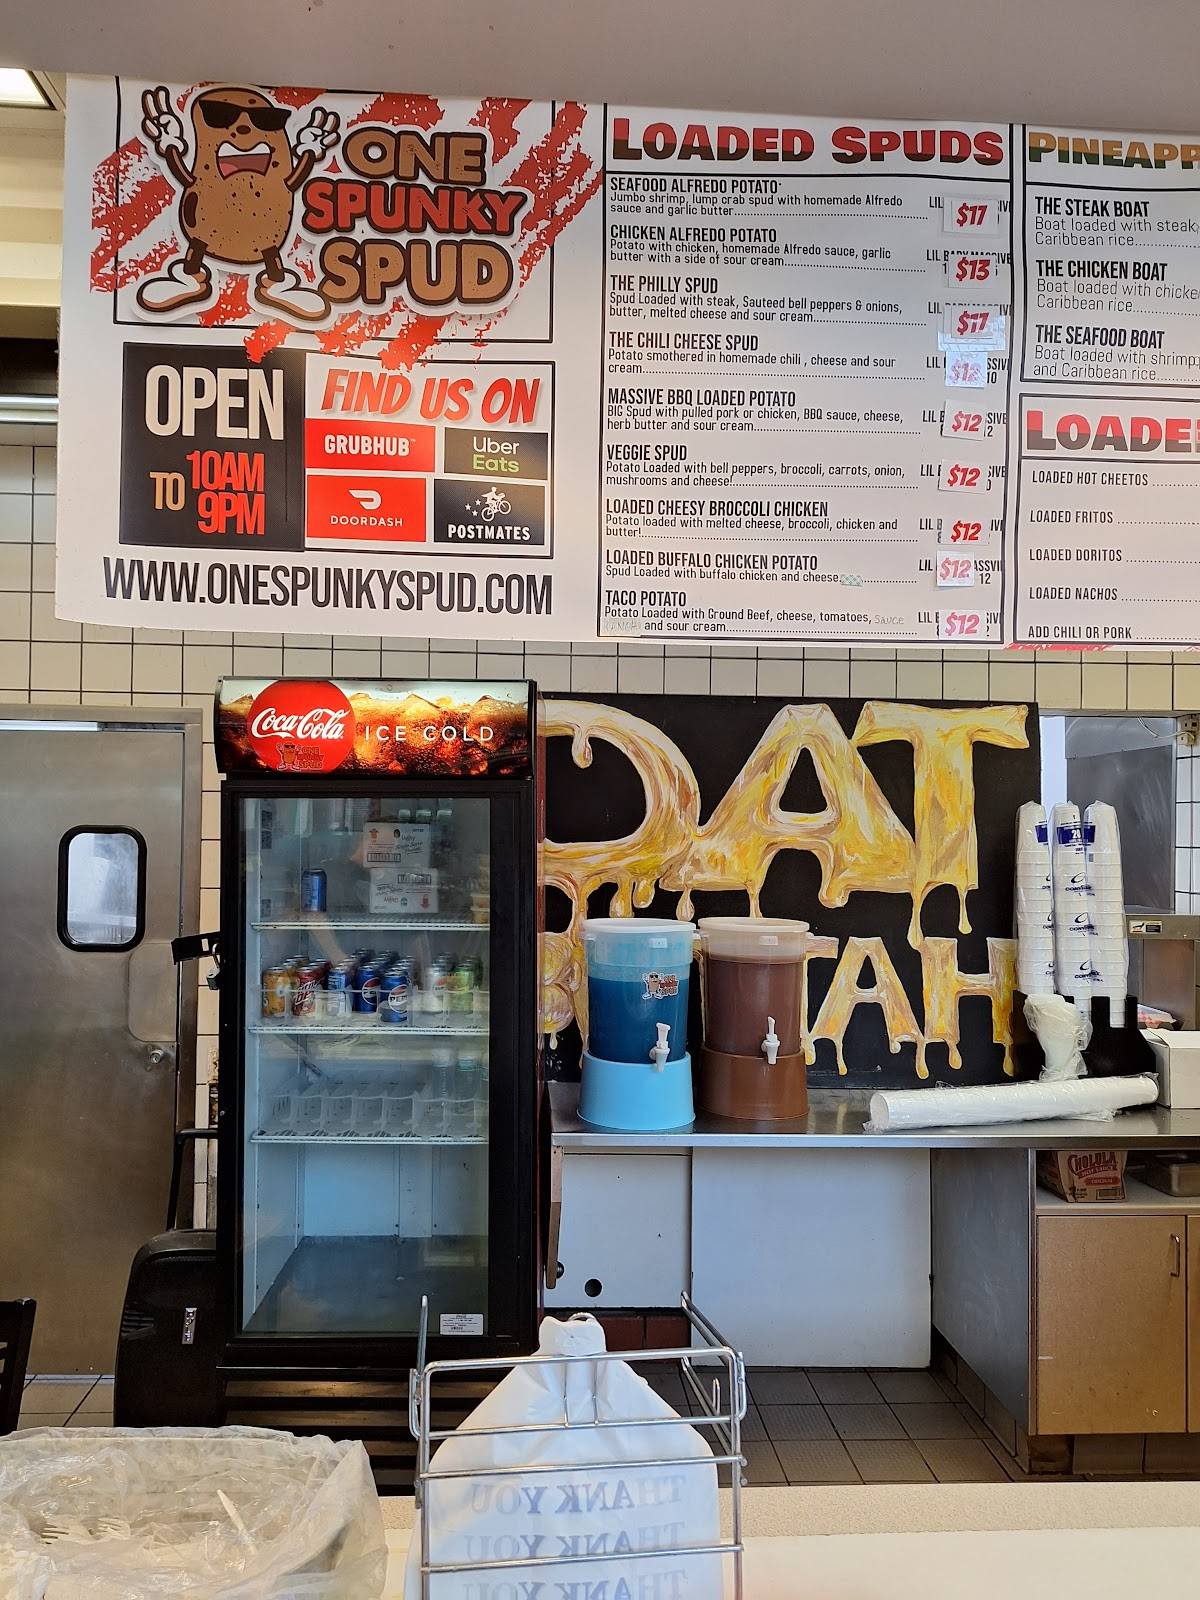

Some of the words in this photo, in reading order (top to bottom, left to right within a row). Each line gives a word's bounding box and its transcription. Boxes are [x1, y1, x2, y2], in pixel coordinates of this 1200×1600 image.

[612, 118, 815, 163] LOADED
[832, 126, 1004, 166] SPUDS
[344, 126, 486, 184] ONE
[610, 176, 666, 193] SEAFOOD
[671, 178, 726, 194] ALFREDO
[303, 180, 527, 235] SPUNKY
[610, 192, 645, 202] Jumbo
[649, 192, 688, 206] shrimp,
[692, 193, 717, 207] lump
[721, 194, 744, 204] crab
[748, 194, 773, 207] spud
[777, 194, 800, 205] with
[804, 194, 861, 206] homemade
[865, 195, 903, 206] Alfredo
[929, 196, 943, 208] LIL
[1034, 196, 1061, 215] THE
[1065, 198, 1109, 217] STEAK
[1114, 200, 1149, 217] BOAT
[611, 204, 641, 214] sauce
[645, 204, 663, 214] and
[667, 204, 697, 217] garlic
[957, 203, 988, 227] $17
[1035, 217, 1066, 231] Boat
[1071, 217, 1115, 231] loaded
[1120, 218, 1151, 231] with
[610, 224, 664, 241] CHICKEN
[669, 227, 725, 242] ALFREDO
[730, 227, 776, 244] POTATO
[610, 239, 644, 252] Potato
[648, 240, 671, 253] with
[675, 242, 718, 256] chicken,
[722, 242, 779, 254] homemade
[783, 244, 820, 255] Alfredo
[824, 247, 857, 258] sauce,
[862, 246, 890, 261] garlic
[610, 251, 643, 263] butter
[647, 252, 670, 262] with
[674, 255, 680, 263] a
[684, 253, 705, 263] side
[709, 253, 719, 264] of
[723, 256, 746, 264] sour
[927, 249, 940, 261] LIL
[321, 239, 513, 305] SPUD
[956, 257, 990, 281] $13
[1035, 259, 1063, 277] THE
[1067, 259, 1128, 279] CHICKEN
[1132, 261, 1167, 281] BOAT
[610, 274, 634, 292] THE
[639, 275, 681, 292] PHILLY
[685, 277, 717, 294] SPUD
[928, 302, 942, 314] LIL
[609, 331, 633, 347] THE
[637, 332, 669, 348] CHILI
[674, 333, 721, 349] CHEESE
[725, 334, 758, 350] SPUD
[1035, 324, 1062, 343] THE
[1065, 325, 1126, 344] SEAFOOD
[1130, 329, 1164, 349] BOAT
[926, 357, 940, 368] LIL
[144, 364, 285, 441] OPEN
[321, 364, 410, 415] FIND
[420, 376, 473, 420] US
[481, 376, 540, 424] ON
[608, 388, 663, 404] MASSIVE
[667, 389, 692, 406] BBQ
[697, 389, 744, 406] LOADED
[749, 390, 795, 406] POTATO
[923, 410, 936, 422] LIL
[952, 411, 982, 432] $12
[1026, 410, 1200, 453] LOADE
[473, 436, 520, 455] Uber
[607, 444, 650, 460] VEGGIE
[654, 444, 686, 460] SPUD
[186, 449, 265, 493] 10AM
[472, 454, 520, 473] Eats
[920, 464, 934, 476] LIL
[947, 464, 980, 487] $12
[1032, 470, 1072, 483] LOADED
[1077, 471, 1097, 484] HOT
[1101, 472, 1147, 485] CHEETOS
[149, 471, 185, 511] TO
[197, 491, 265, 536] 9PM
[606, 498, 653, 516] LOADED
[658, 500, 705, 517] CHEESY
[709, 500, 769, 516] BROCCOLI
[774, 501, 827, 518] CHICKEN
[1030, 509, 1071, 523] LOADED
[1075, 511, 1112, 523] FRITOS
[330, 515, 403, 527] DOORDASH
[606, 515, 639, 526] Potato
[643, 516, 676, 526] loaded
[680, 516, 702, 527] with
[706, 517, 741, 528] melted
[745, 517, 784, 530] cheese,
[788, 517, 832, 531] broccoli,
[836, 518, 875, 529] chicken
[878, 518, 897, 529] and
[920, 518, 933, 530] LIL
[448, 523, 531, 541] POSTMATES
[951, 520, 981, 542] $12
[606, 549, 653, 567] LOADED
[658, 551, 710, 568] BUFFALO
[715, 553, 767, 569] CHICKEN
[772, 554, 817, 570] POTATO
[1030, 548, 1071, 560] LOADED
[1076, 548, 1121, 561] DORITOS
[919, 559, 933, 571] LIL
[940, 558, 972, 580] $12
[103, 556, 553, 615] WWW.ONESPUNKYSPUD.COM
[979, 573, 991, 584] 12
[605, 590, 636, 606] TACO
[641, 590, 686, 606] POTATO
[1029, 587, 1070, 599] LOADED
[1075, 587, 1117, 600] NACHOS
[604, 607, 638, 617] Potato
[641, 607, 677, 618] Loaded
[681, 608, 704, 619] with
[708, 609, 743, 619] Ground
[747, 609, 772, 622] Beef,
[776, 610, 815, 623] cheese,
[819, 612, 871, 624] tomatoes,
[644, 619, 662, 630] and
[666, 622, 689, 631] sour
[918, 612, 932, 623] LIL
[945, 612, 980, 636] $12
[1028, 625, 1049, 637] ADD
[1053, 626, 1081, 638] CHILI
[1086, 626, 1099, 638] OR
[1103, 626, 1131, 638] PORK
[251, 708, 351, 740] Coca-Cola
[366, 725, 407, 741] ICE
[423, 725, 494, 741] COLD
